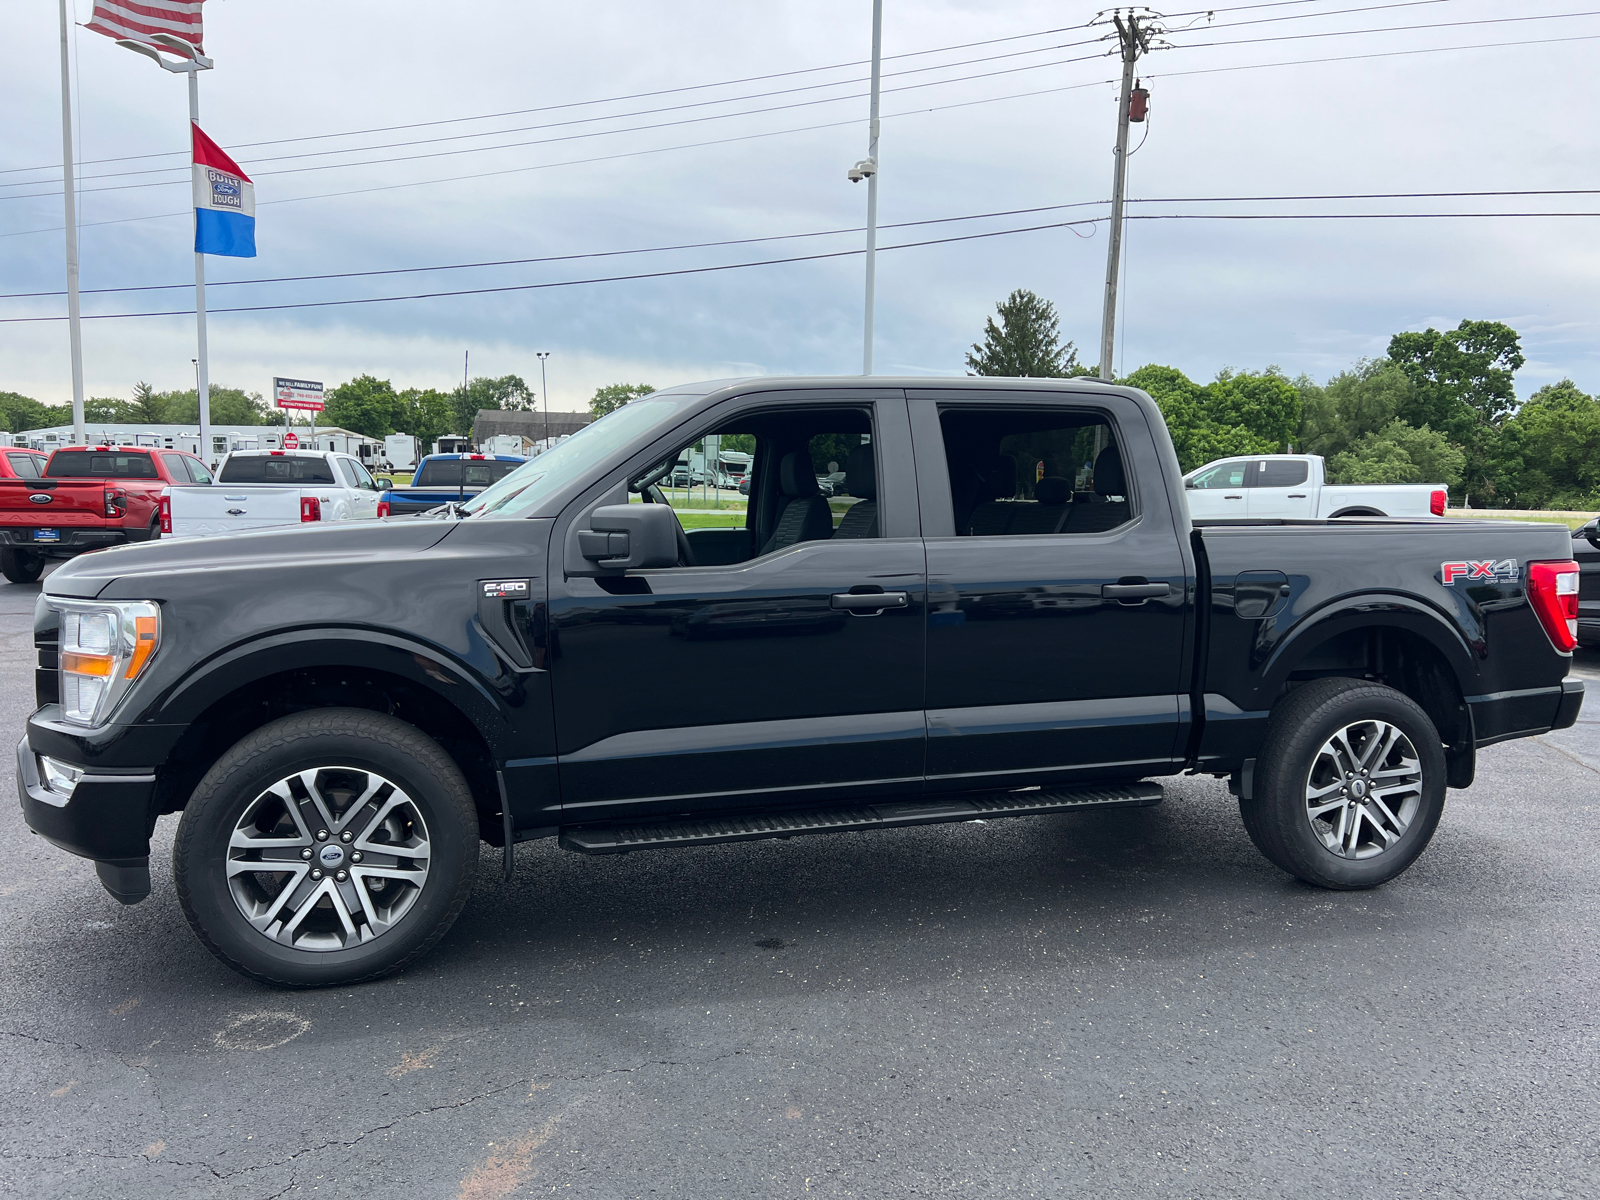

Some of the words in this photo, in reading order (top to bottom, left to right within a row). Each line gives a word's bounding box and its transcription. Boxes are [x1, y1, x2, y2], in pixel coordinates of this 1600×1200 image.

[209, 171, 239, 187] BUILT
[213, 194, 240, 206] TOUGH
[1441, 558, 1519, 587] FX4
[484, 582, 527, 591] F-150
